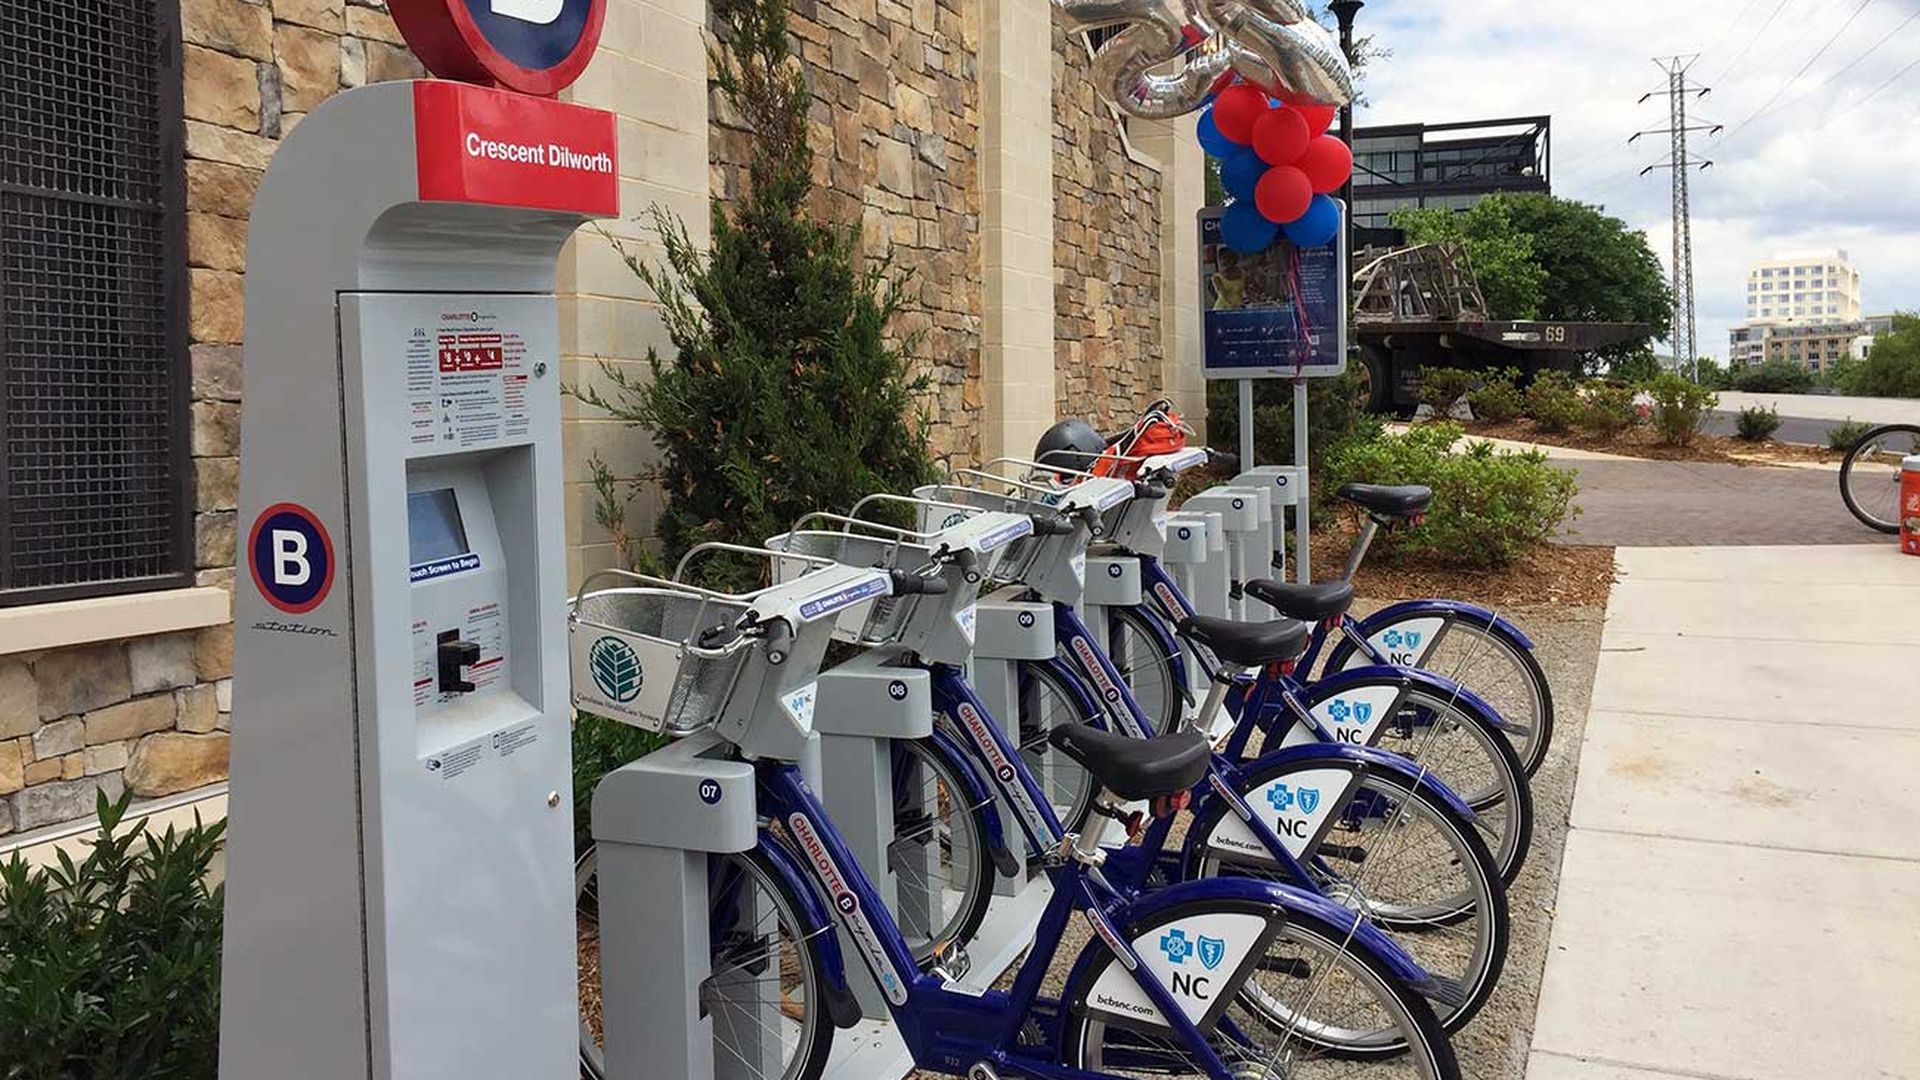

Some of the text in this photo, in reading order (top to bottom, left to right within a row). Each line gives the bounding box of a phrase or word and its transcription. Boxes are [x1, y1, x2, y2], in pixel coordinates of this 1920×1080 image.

[466, 131, 613, 174] Crescent Dilworth
[1545, 326, 1565, 342] 69
[272, 529, 311, 586] B
[410, 557, 479, 578] ouch Screen to Begin
[1110, 566, 1120, 575] 10
[251, 621, 338, 637] station
[1019, 614, 1033, 625] 09
[1074, 639, 1110, 690] CHARLOTTE
[1390, 653, 1412, 666] NC
[889, 684, 906, 696] 08
[962, 707, 1005, 768] CHARLOTTE
[1000, 769, 1011, 780] B
[1336, 727, 1363, 744] NC
[701, 785, 718, 799] 07
[1276, 816, 1308, 839] NC
[1216, 836, 1263, 851] bcbsnc.com
[793, 817, 844, 894] CHARLOTTE
[840, 897, 853, 910] B
[1171, 971, 1210, 1000] NC
[1096, 994, 1154, 1016] bcbsnc.com
